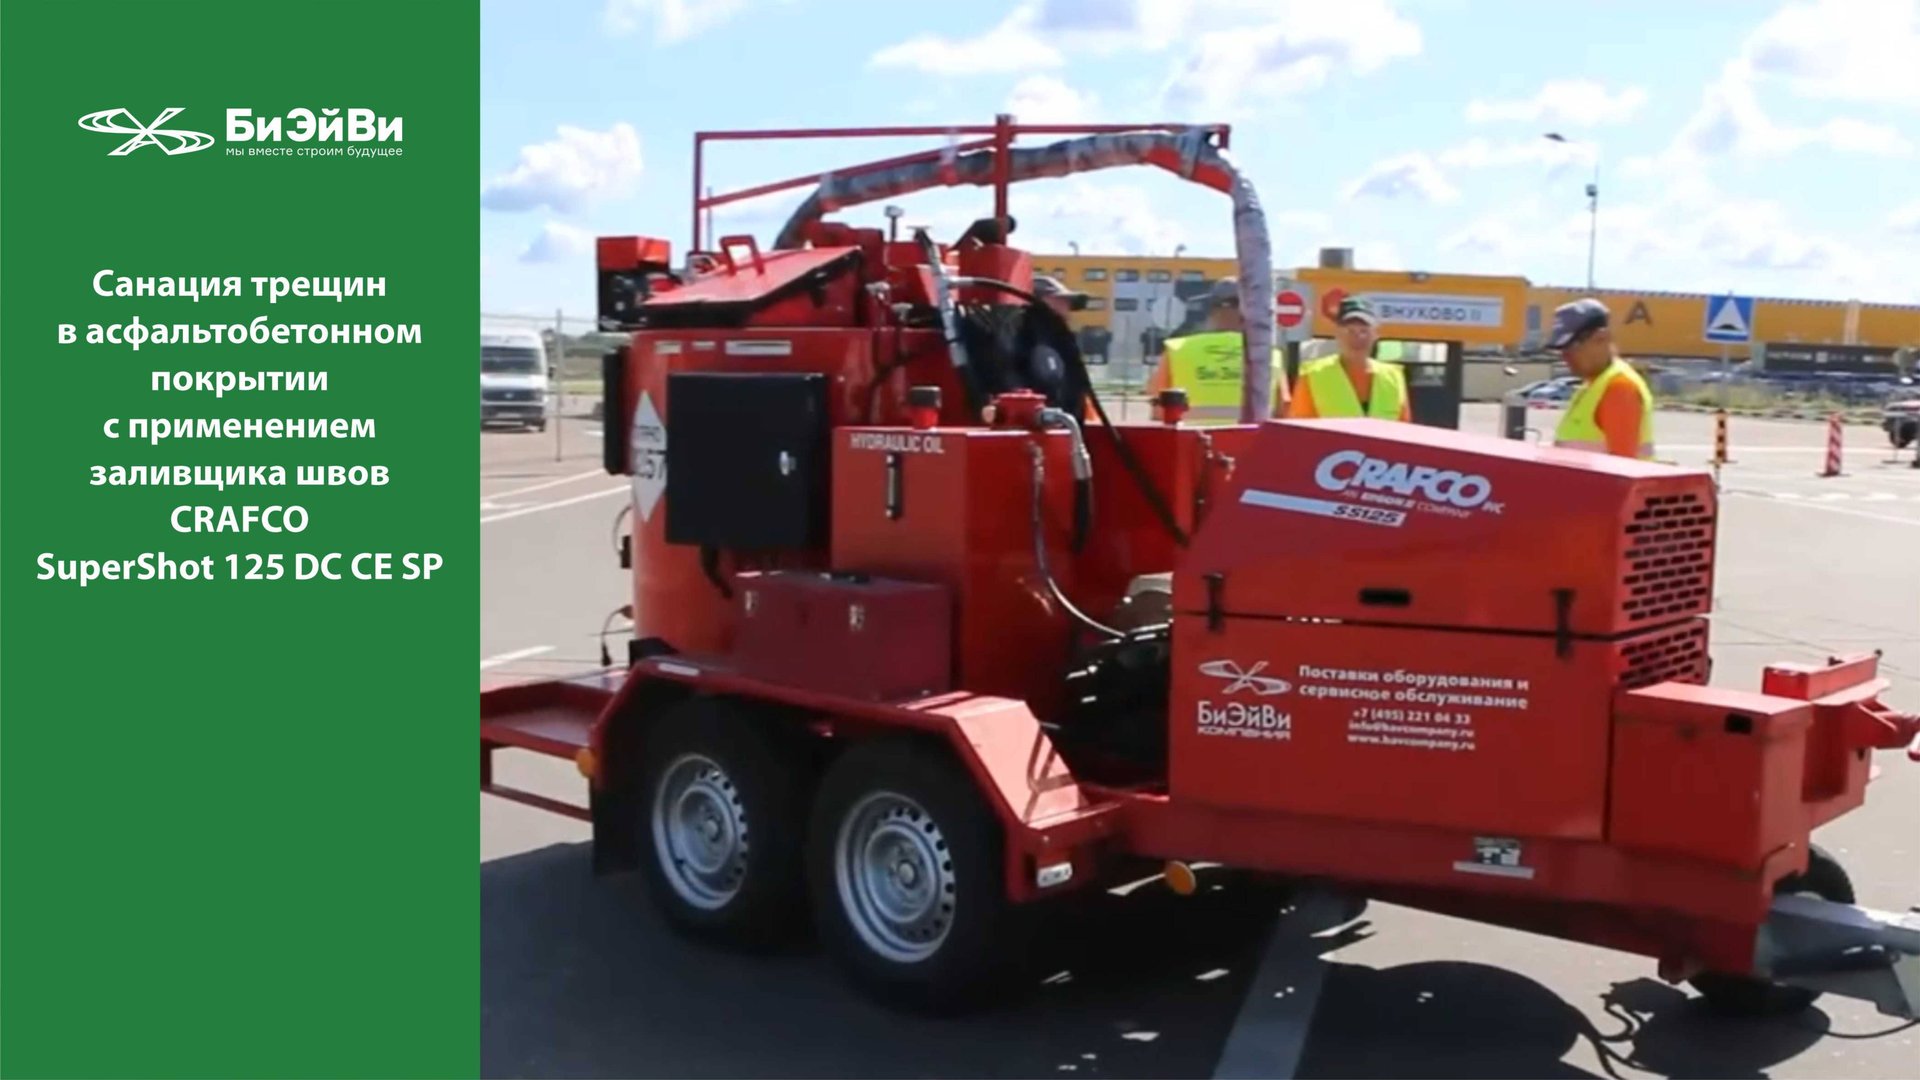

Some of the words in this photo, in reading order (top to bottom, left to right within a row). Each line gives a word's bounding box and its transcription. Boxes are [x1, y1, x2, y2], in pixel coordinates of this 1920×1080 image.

[1381, 304, 1466, 321] ВНУКОВО
[850, 432, 921, 452] HYDRAULIC
[923, 435, 945, 454] OIL
[1314, 449, 1492, 508] CRAFCO
[1333, 504, 1400, 525] SS125
[1299, 664, 1379, 684] Поставки
[1382, 667, 1514, 693] оборудования
[1516, 679, 1530, 691] и
[1299, 683, 1391, 701] сервисное
[1394, 687, 1529, 710] обслуживание
[1197, 700, 1292, 730] БиЭйВи
[1352, 707, 1369, 719] +7
[1371, 707, 1404, 721] (495)
[1407, 709, 1430, 722] 221
